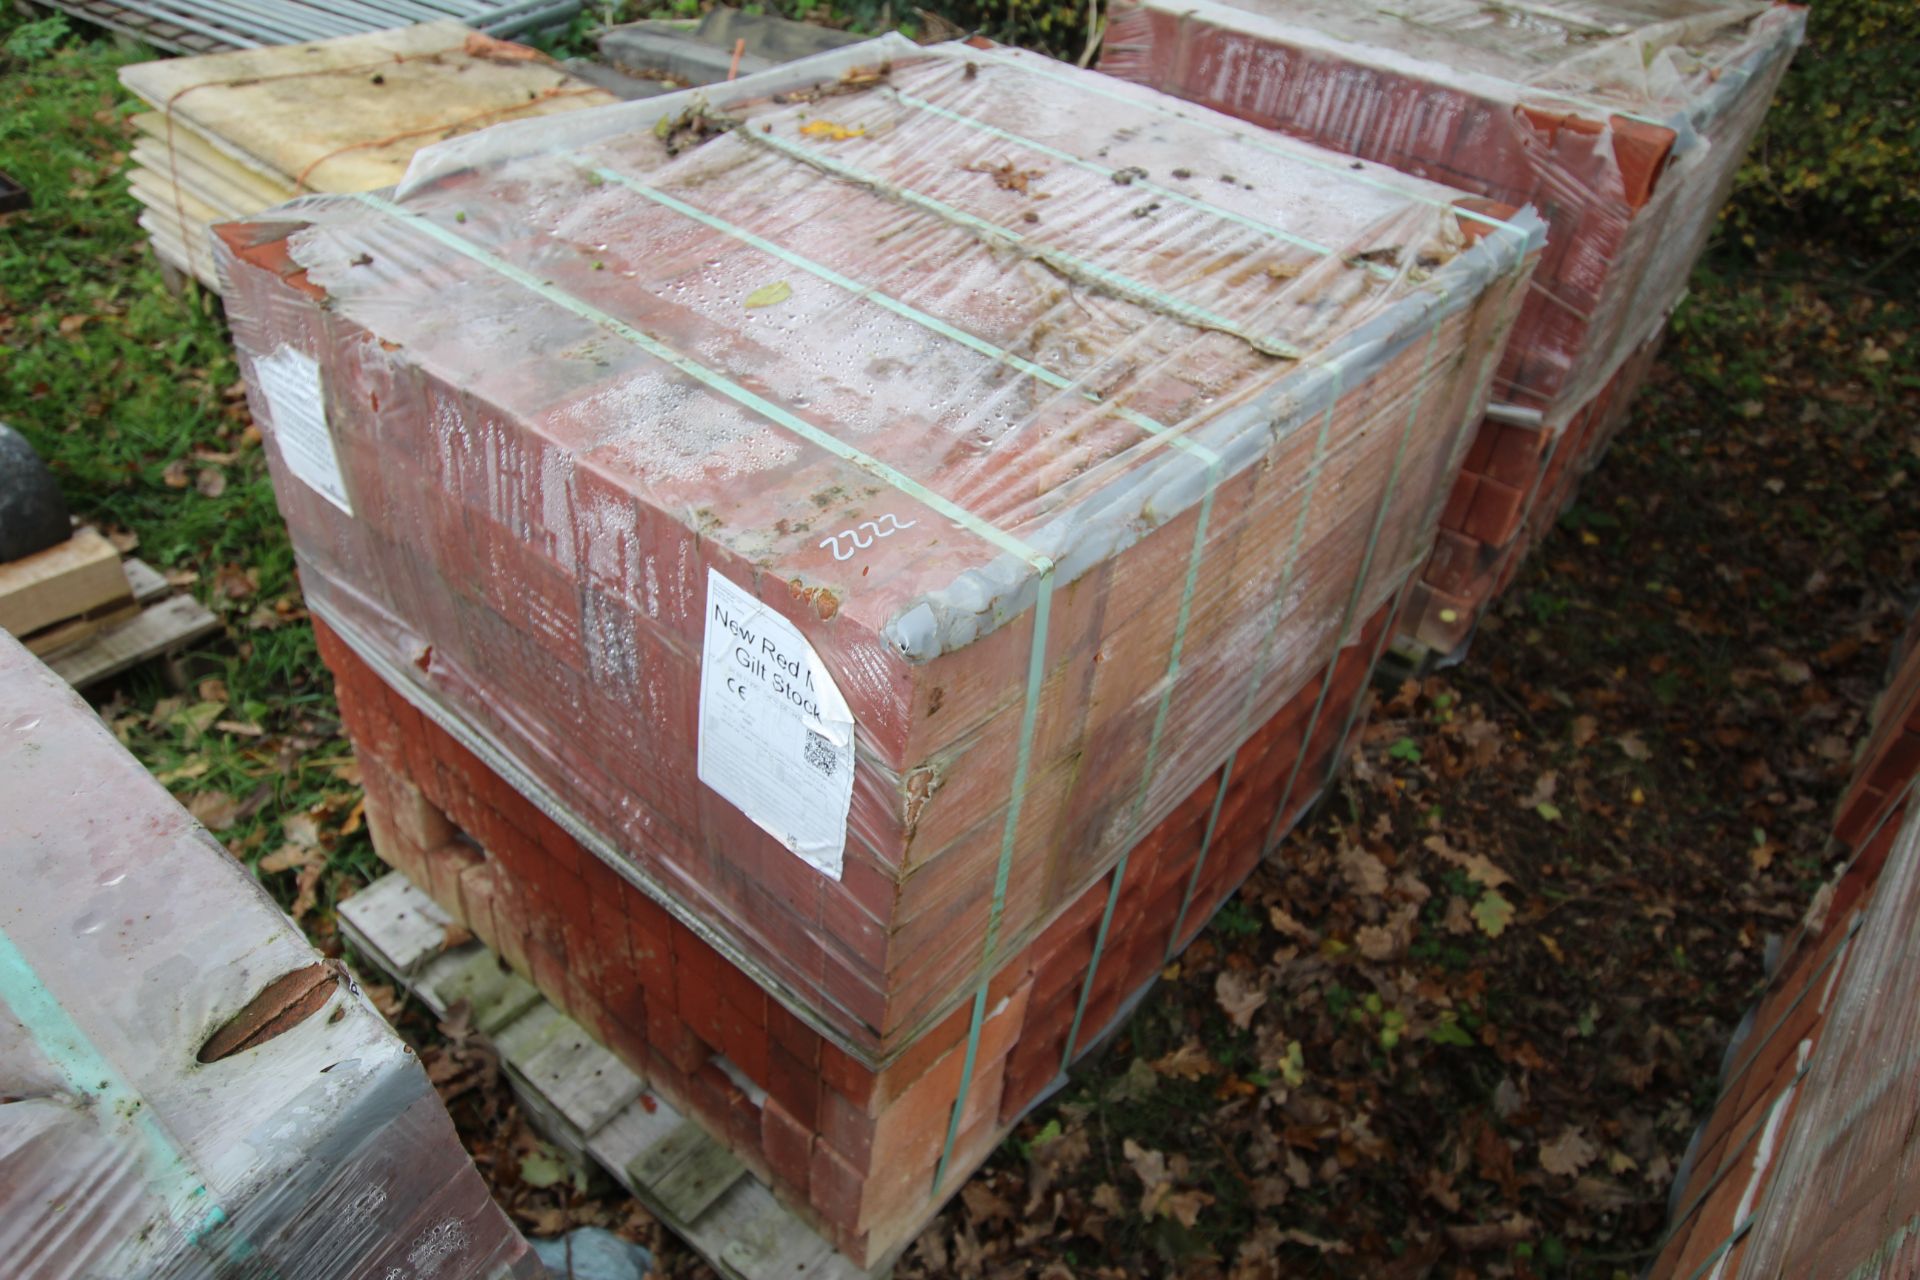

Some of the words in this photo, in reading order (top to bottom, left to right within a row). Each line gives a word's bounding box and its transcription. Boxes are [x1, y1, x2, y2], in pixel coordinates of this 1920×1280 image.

[715, 604, 755, 645] New
[762, 637, 800, 678] Red
[735, 647, 766, 681] Gilt
[772, 672, 822, 724] Stock
